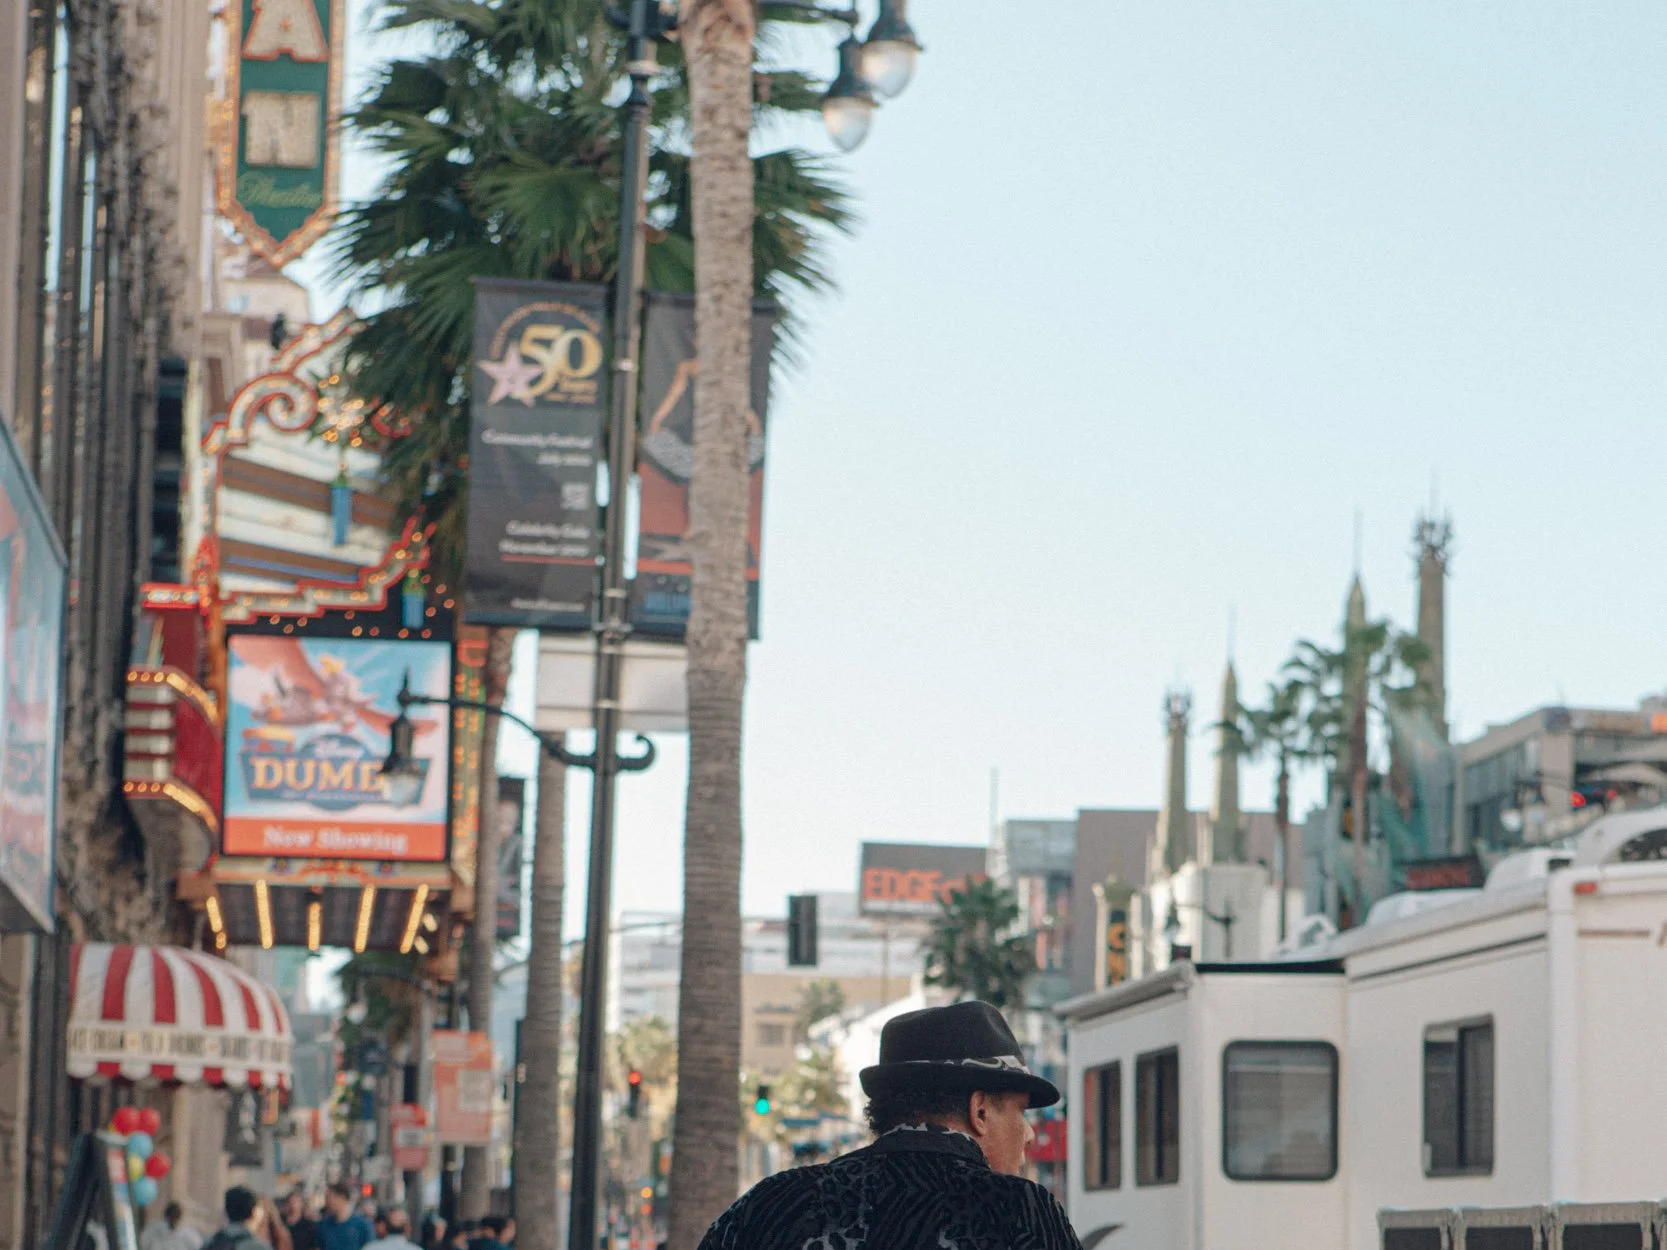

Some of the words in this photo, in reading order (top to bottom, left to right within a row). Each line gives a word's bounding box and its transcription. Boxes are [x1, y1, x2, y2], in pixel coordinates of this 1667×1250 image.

[519, 322, 604, 399] 50
[250, 755, 385, 793] DUMB
[263, 826, 313, 848] Now
[317, 827, 408, 855] Showing
